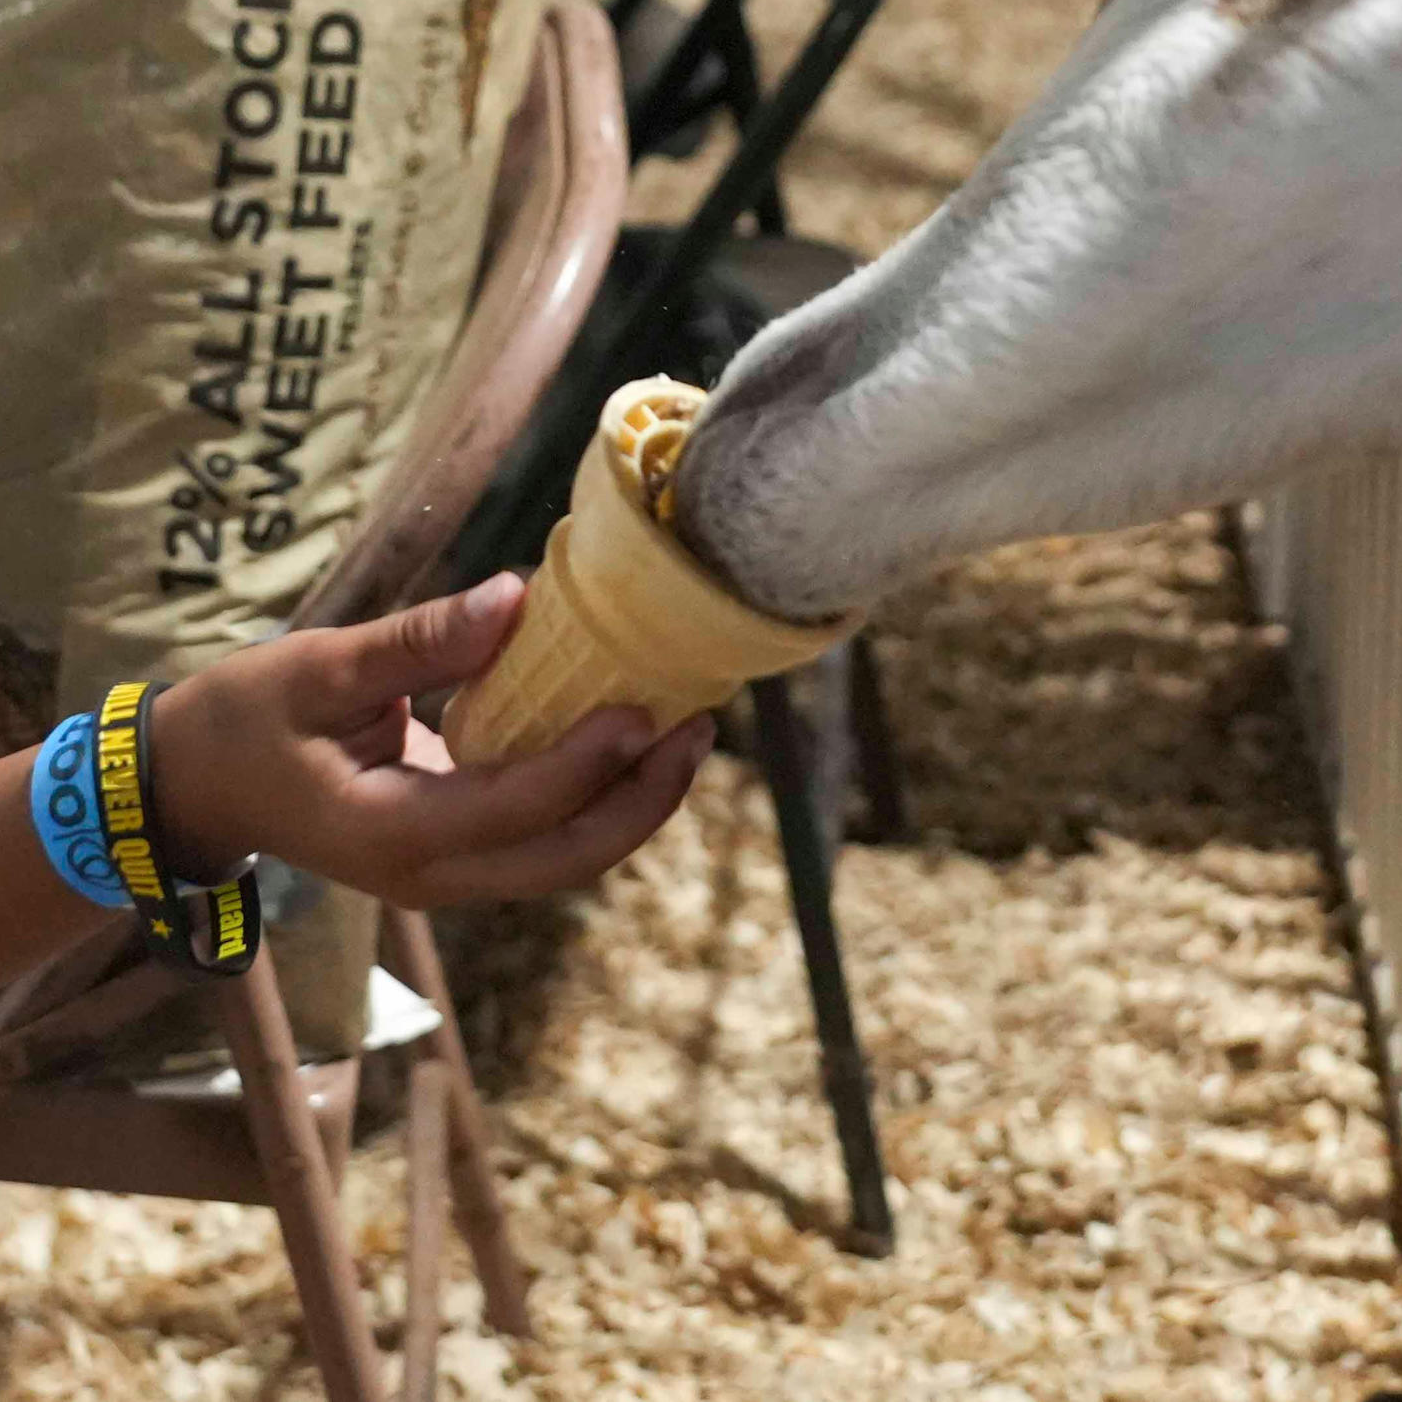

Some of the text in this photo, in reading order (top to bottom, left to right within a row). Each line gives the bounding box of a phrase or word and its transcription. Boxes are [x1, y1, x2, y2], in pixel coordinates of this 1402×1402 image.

[189, 271, 262, 427] ALL
[241, 9, 364, 553] SWEET FEED
[159, 448, 242, 596] 12%
[98, 726, 145, 833] NEVER
[111, 837, 165, 901] QUIT
